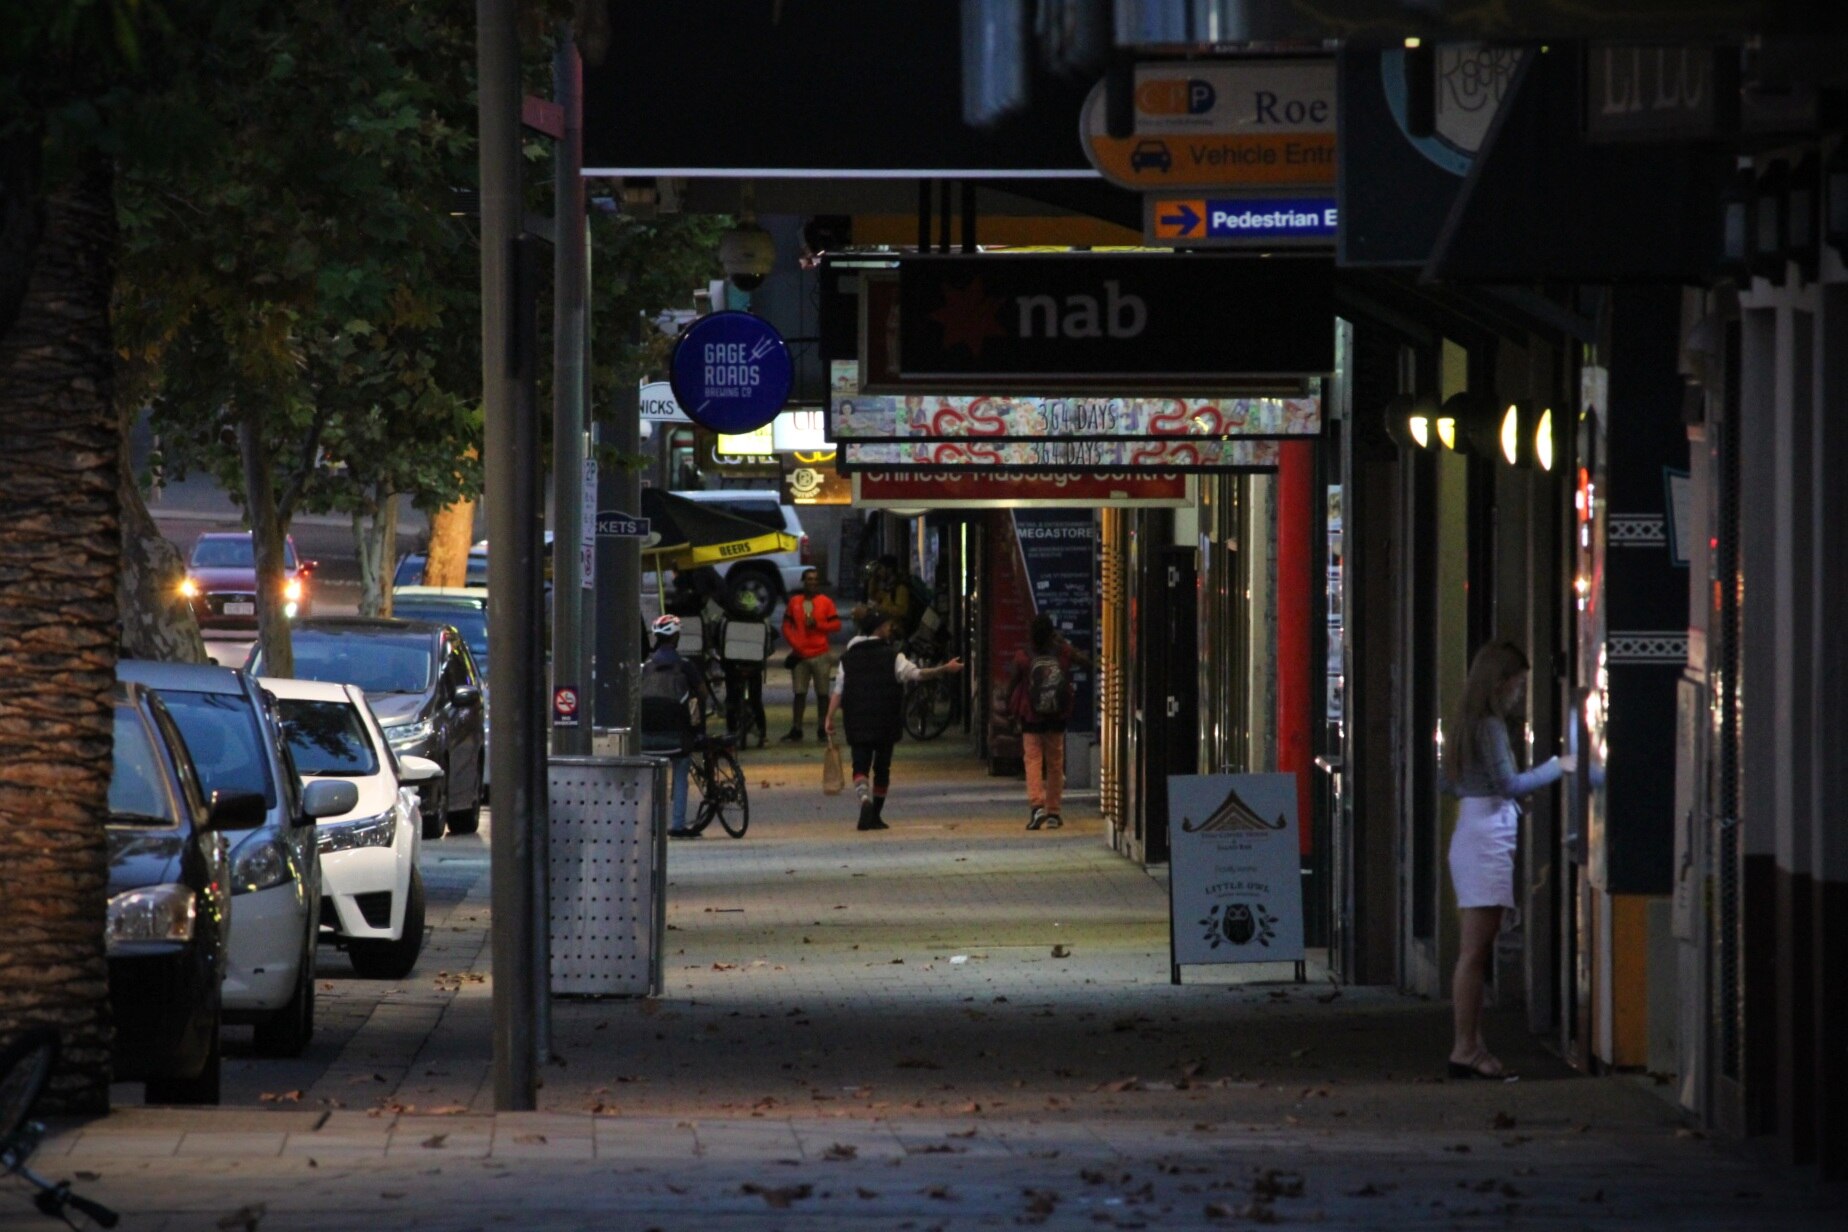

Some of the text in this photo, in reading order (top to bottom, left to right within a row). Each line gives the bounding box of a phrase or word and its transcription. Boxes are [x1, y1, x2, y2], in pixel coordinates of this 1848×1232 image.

[1255, 91, 1329, 124] Roe
[1191, 143, 1277, 165] Vehicle
[1212, 209, 1320, 229] Pedestrian
[1015, 279, 1149, 340] nab
[704, 343, 747, 364] GAGE
[704, 365, 760, 386] ROADS
[704, 387, 739, 398] BREWING
[1038, 403, 1116, 431] 364 DAYS
[1066, 441, 1102, 465] DAYS
[594, 521, 638, 534] KETS
[1017, 528, 1093, 539] MEGASTORE
[718, 541, 752, 557] BEERS
[1205, 881, 1243, 895] LITTLE
[1246, 882, 1270, 893] OWL
